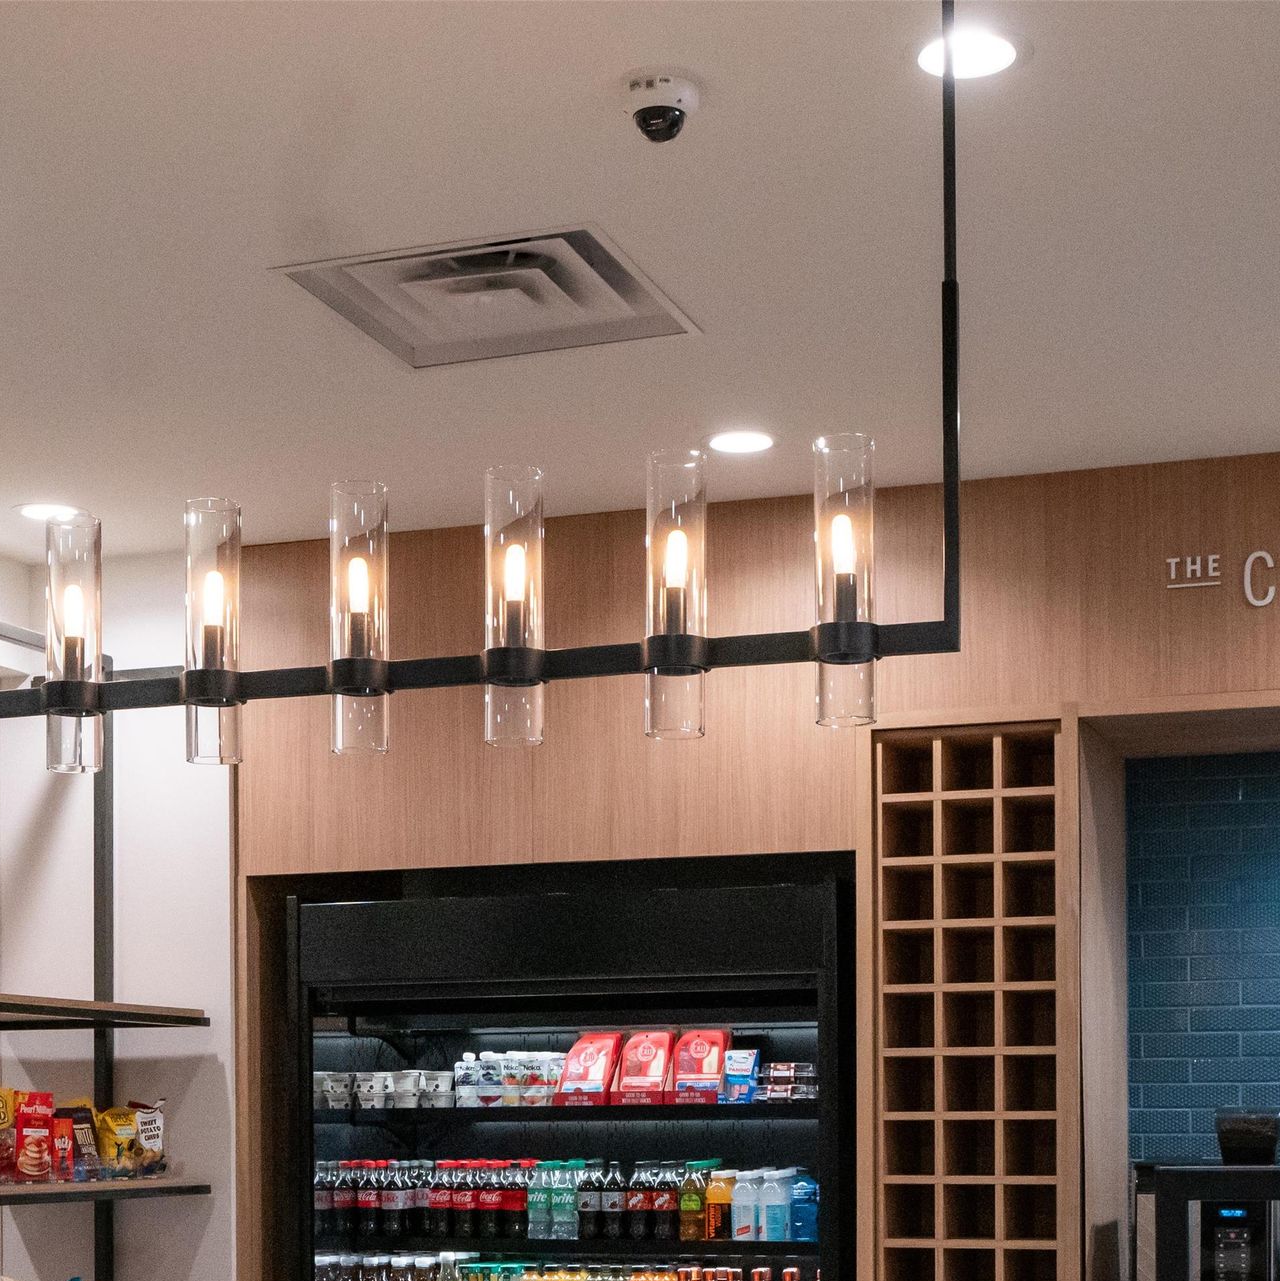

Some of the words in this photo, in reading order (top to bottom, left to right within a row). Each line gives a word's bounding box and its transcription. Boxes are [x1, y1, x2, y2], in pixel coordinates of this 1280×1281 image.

[1166, 555, 1221, 580] THE
[140, 1118, 157, 1128] SWEET
[140, 1125, 162, 1134] POTATO
